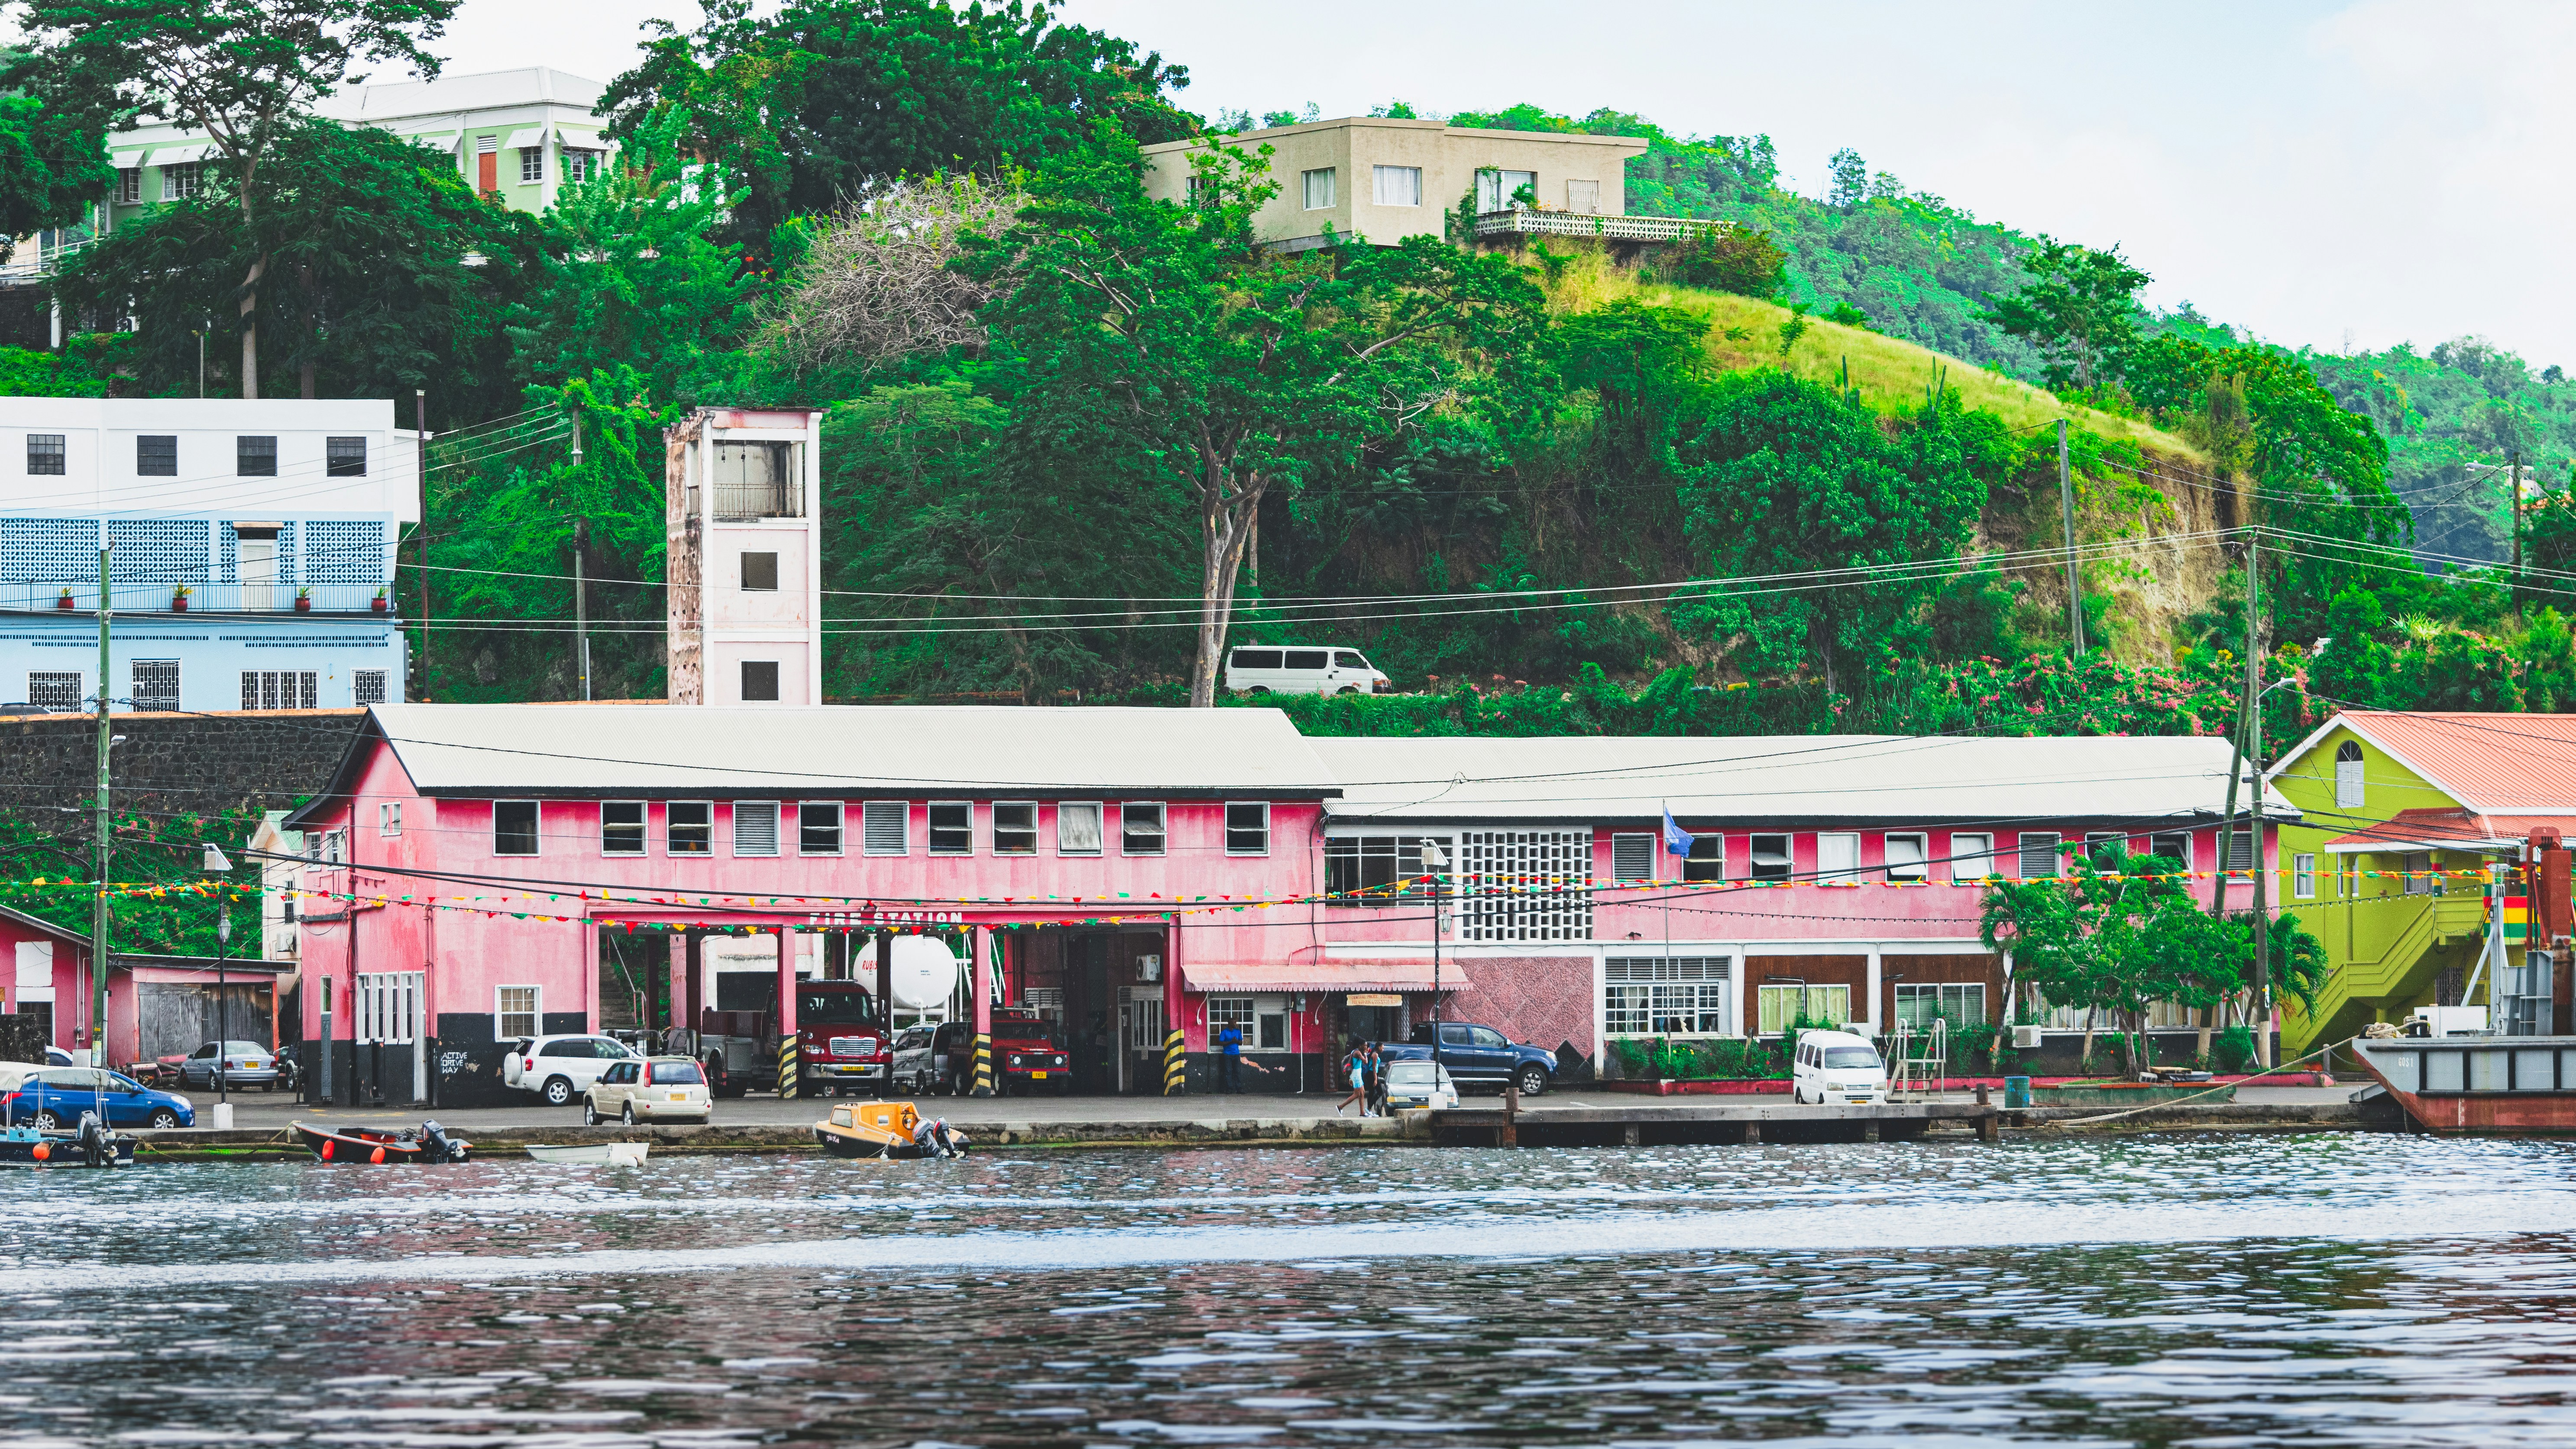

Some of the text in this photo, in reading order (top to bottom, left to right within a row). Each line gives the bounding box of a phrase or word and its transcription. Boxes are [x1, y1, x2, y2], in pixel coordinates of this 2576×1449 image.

[809, 912, 962, 925] FIRE STATION
[2398, 1057, 2409, 1067] GOS
